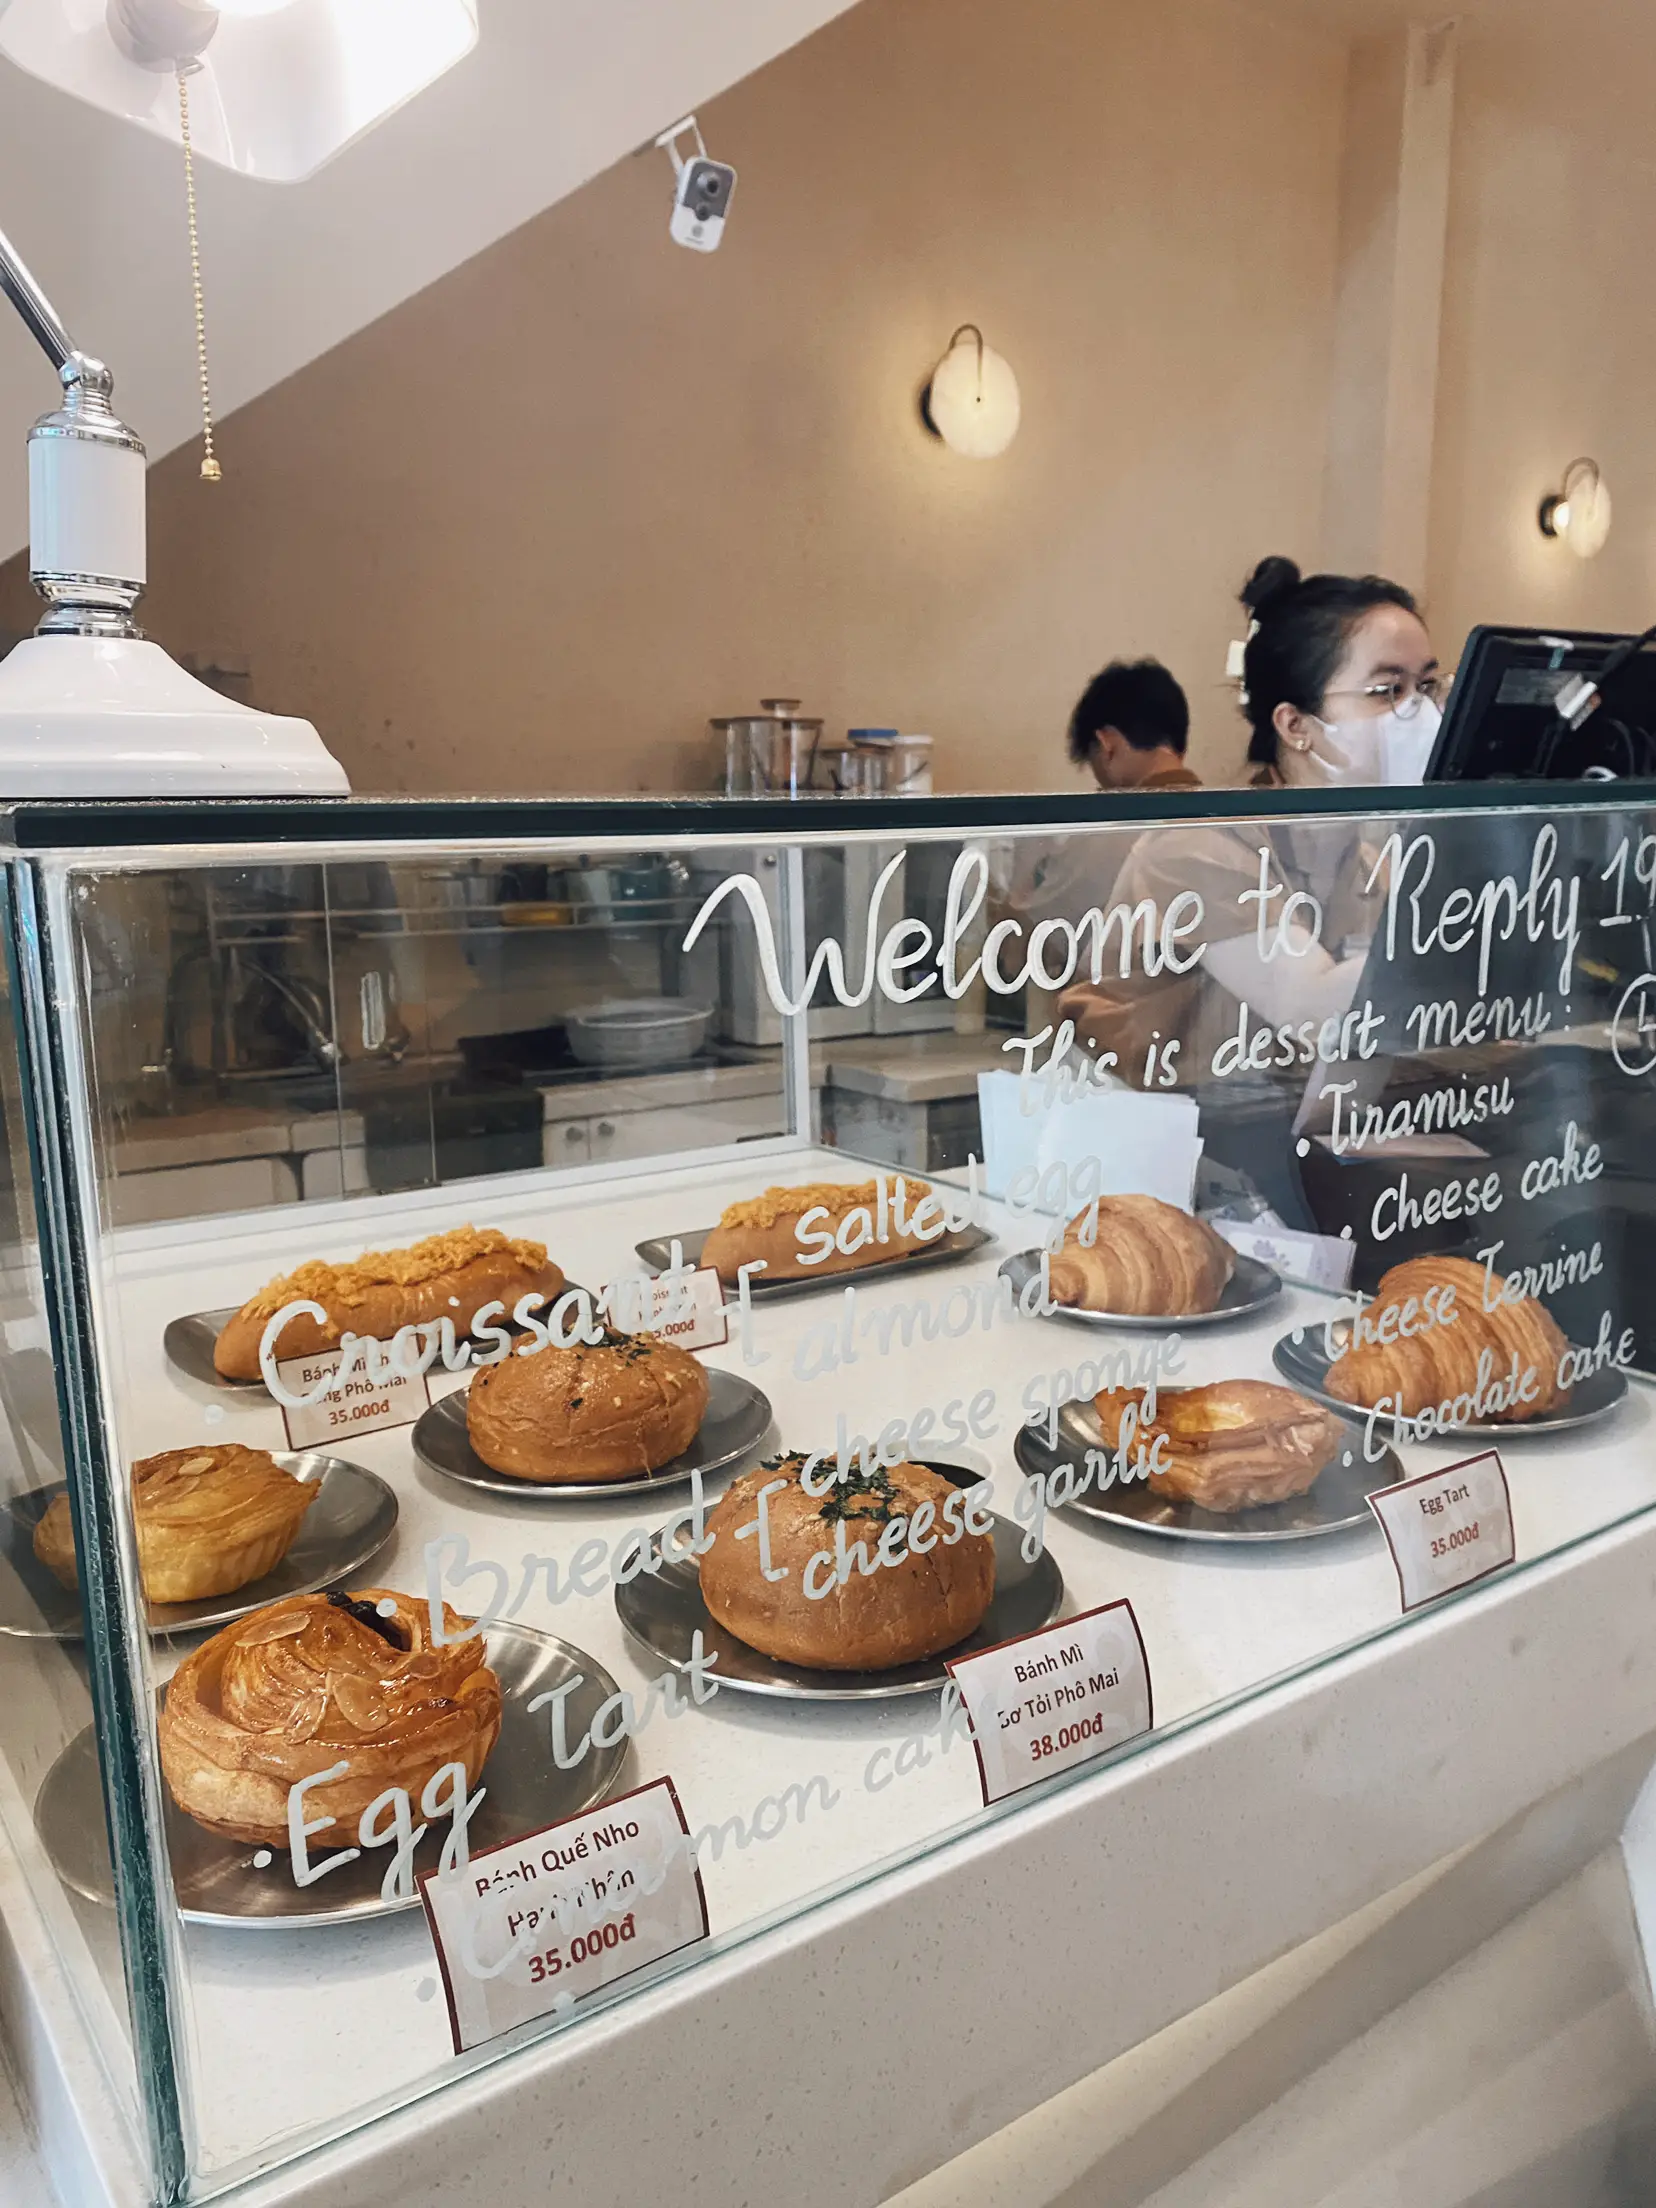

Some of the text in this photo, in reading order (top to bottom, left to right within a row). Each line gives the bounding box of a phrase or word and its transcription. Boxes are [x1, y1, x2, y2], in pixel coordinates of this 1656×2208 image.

[683, 848, 1207, 1016] Welcome
[1238, 847, 1322, 963] to
[1365, 823, 1580, 996] Reply
[1002, 1019, 1118, 1116] This
[1144, 1031, 1180, 1086] is
[1212, 1001, 1385, 1077] dessert
[1319, 1073, 1514, 1156] Tiramisu
[793, 1153, 1103, 1266] salted egg
[1371, 1120, 1604, 1241] Cheese cake
[259, 1239, 696, 1408] Croissant
[792, 1251, 1058, 1382] almond
[1324, 1240, 1604, 1362] Cheese Terrine
[328, 1399, 391, 1425] 35.000đ
[345, 1378, 374, 1398] Phô
[801, 1333, 1186, 1498] cheese sponge
[1364, 1310, 1637, 1464] Chocolate cake
[802, 1401, 1173, 1600] cheese garlic
[1419, 1483, 1470, 1516] Egg Tart
[1430, 1521, 1480, 1558] 35.000đ
[424, 1468, 716, 1648] Bread
[1014, 1643, 1084, 1683] Bánh Mì
[1024, 1695, 1052, 1719] Tỏi
[1054, 1681, 1086, 1708] Phô
[1089, 1667, 1119, 1695] Mai
[287, 1630, 720, 1901] Egg Tart
[1029, 1711, 1104, 1762] 38.000đ
[541, 1831, 589, 1872] Quế
[592, 1820, 640, 1852] Nho
[528, 1911, 636, 1984] 35.000đ
